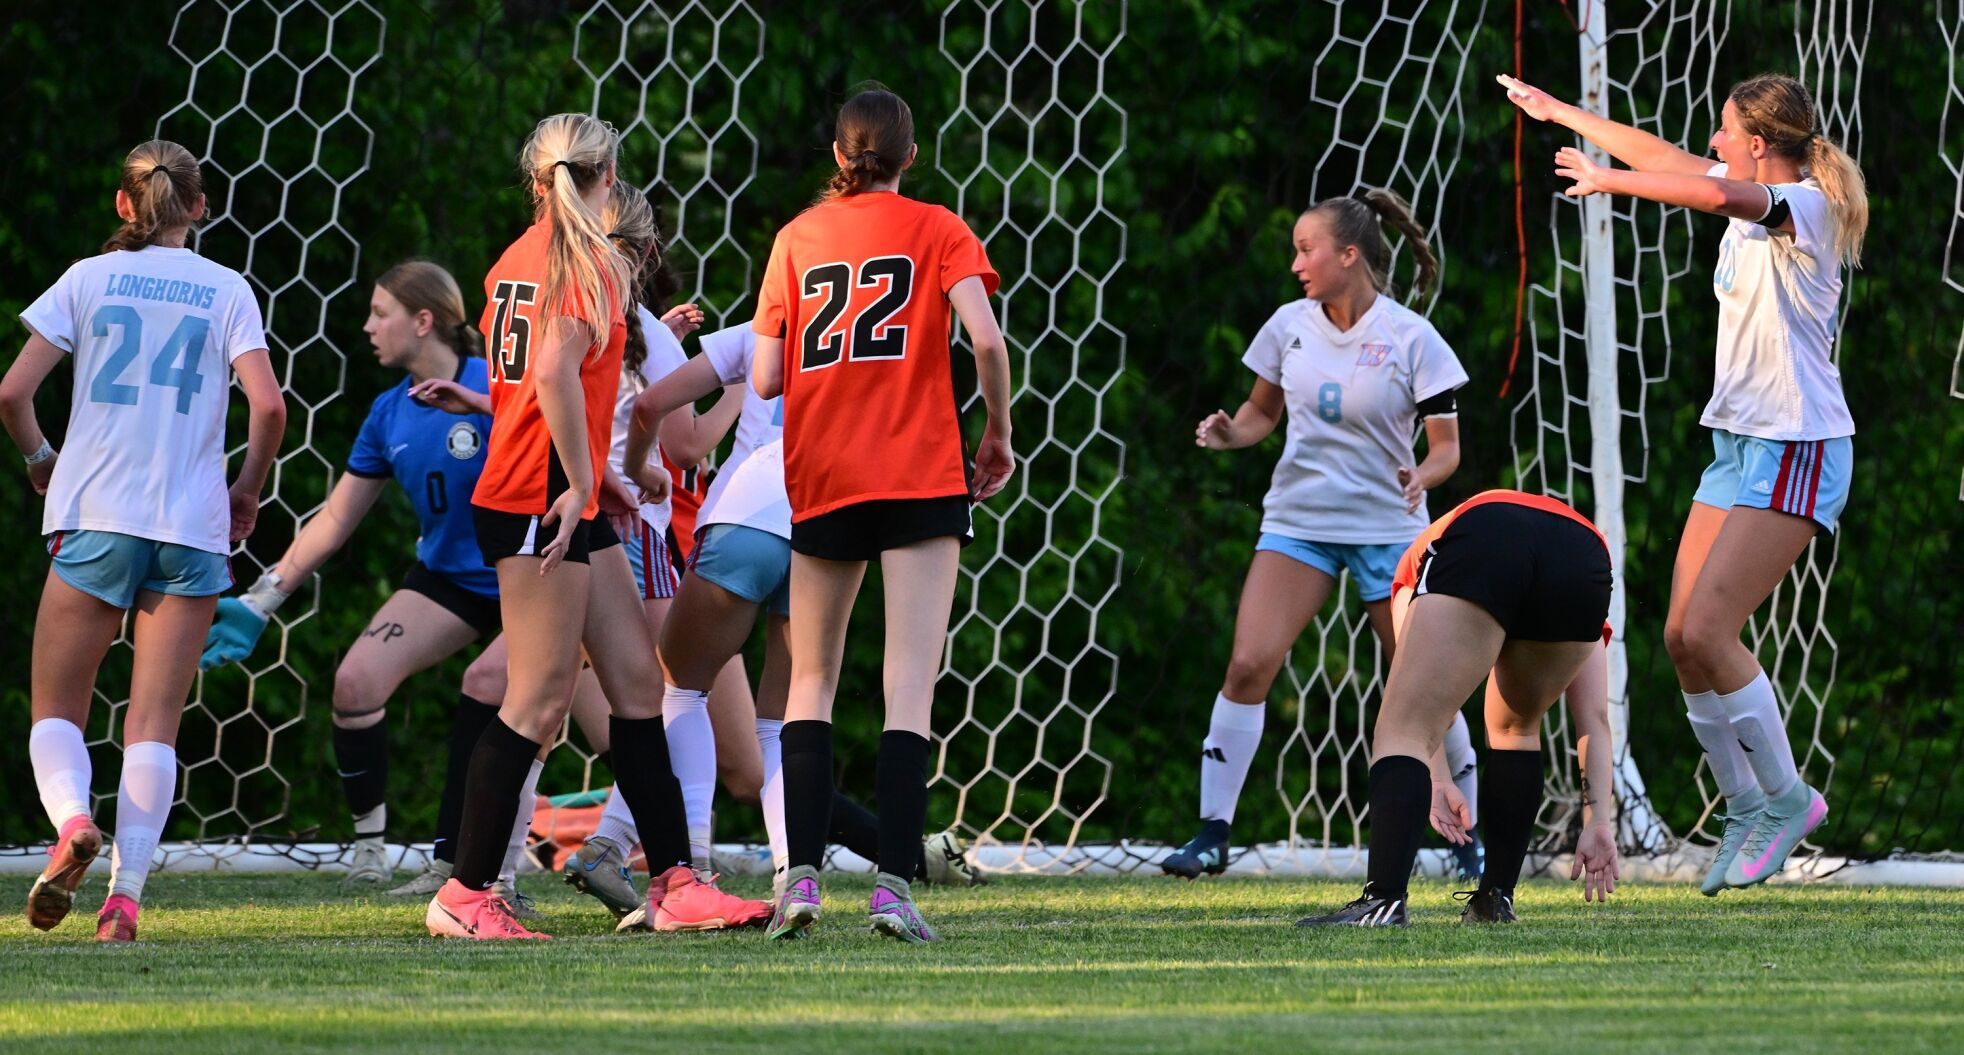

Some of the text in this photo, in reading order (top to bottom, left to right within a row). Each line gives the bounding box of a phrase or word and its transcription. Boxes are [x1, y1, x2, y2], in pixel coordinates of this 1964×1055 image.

[104, 273, 217, 310] LONGHORNS
[800, 254, 915, 373] 22
[90, 304, 211, 416] 24
[1318, 382, 1343, 424] 8
[426, 470, 448, 515] 0
